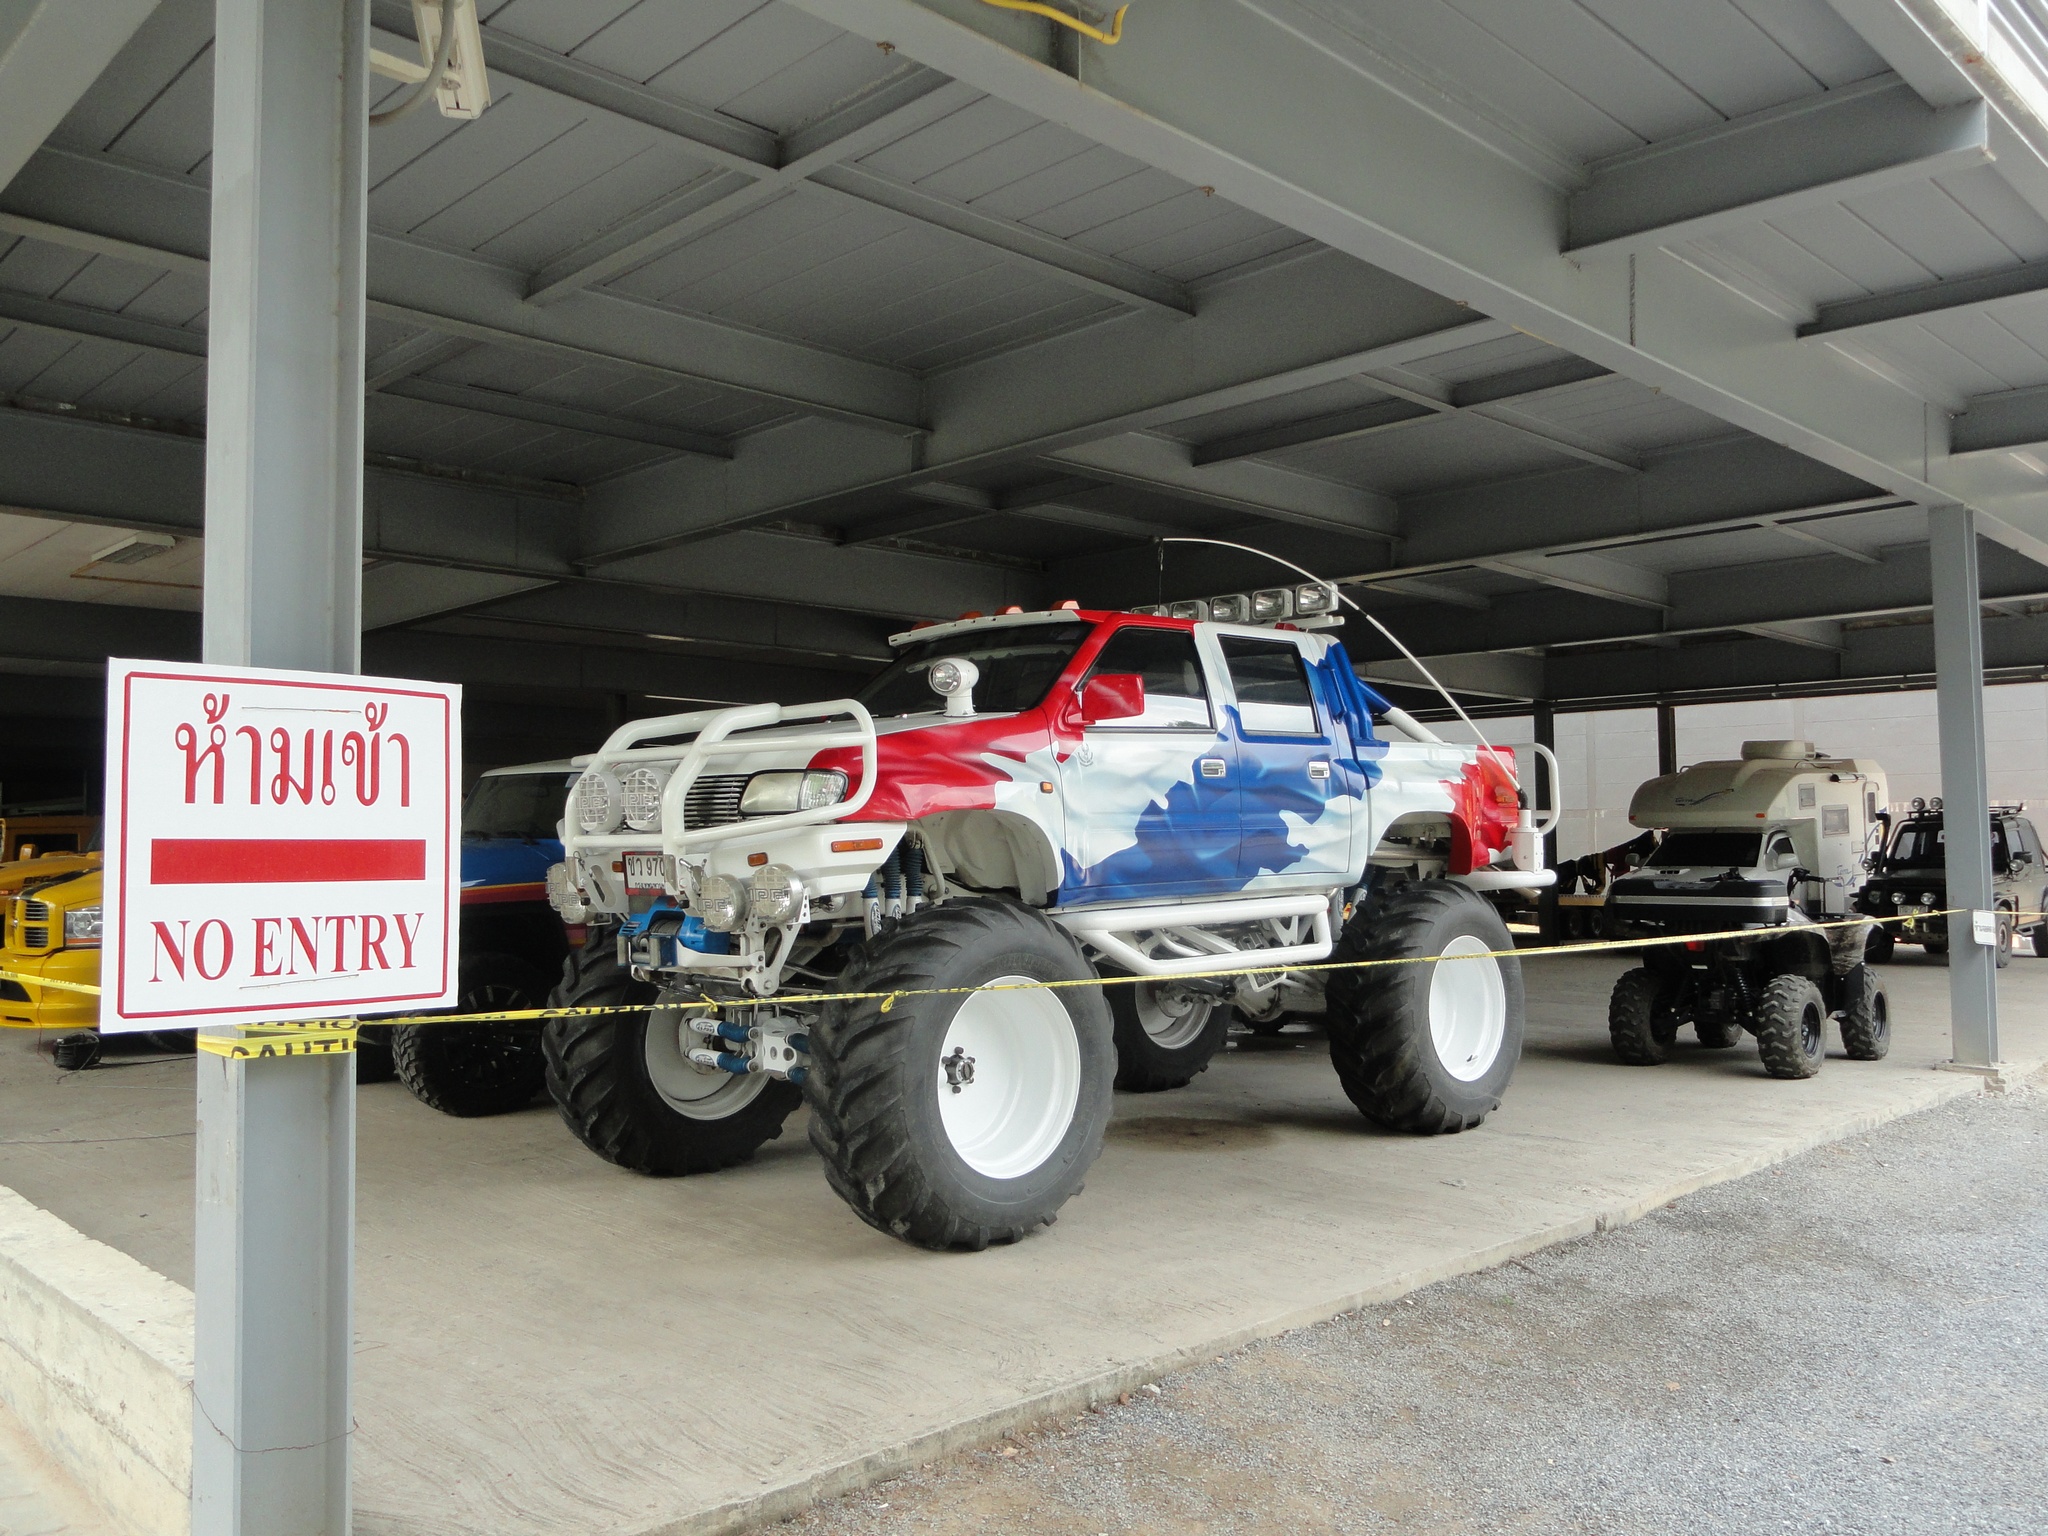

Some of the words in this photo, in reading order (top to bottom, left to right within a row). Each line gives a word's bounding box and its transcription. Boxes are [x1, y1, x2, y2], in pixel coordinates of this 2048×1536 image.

[174, 693, 410, 807] ห้ามเข้า
[697, 898, 732, 912] IPF
[748, 888, 786, 902] IPF
[149, 919, 234, 983] NO
[250, 912, 425, 977] ENTRY
